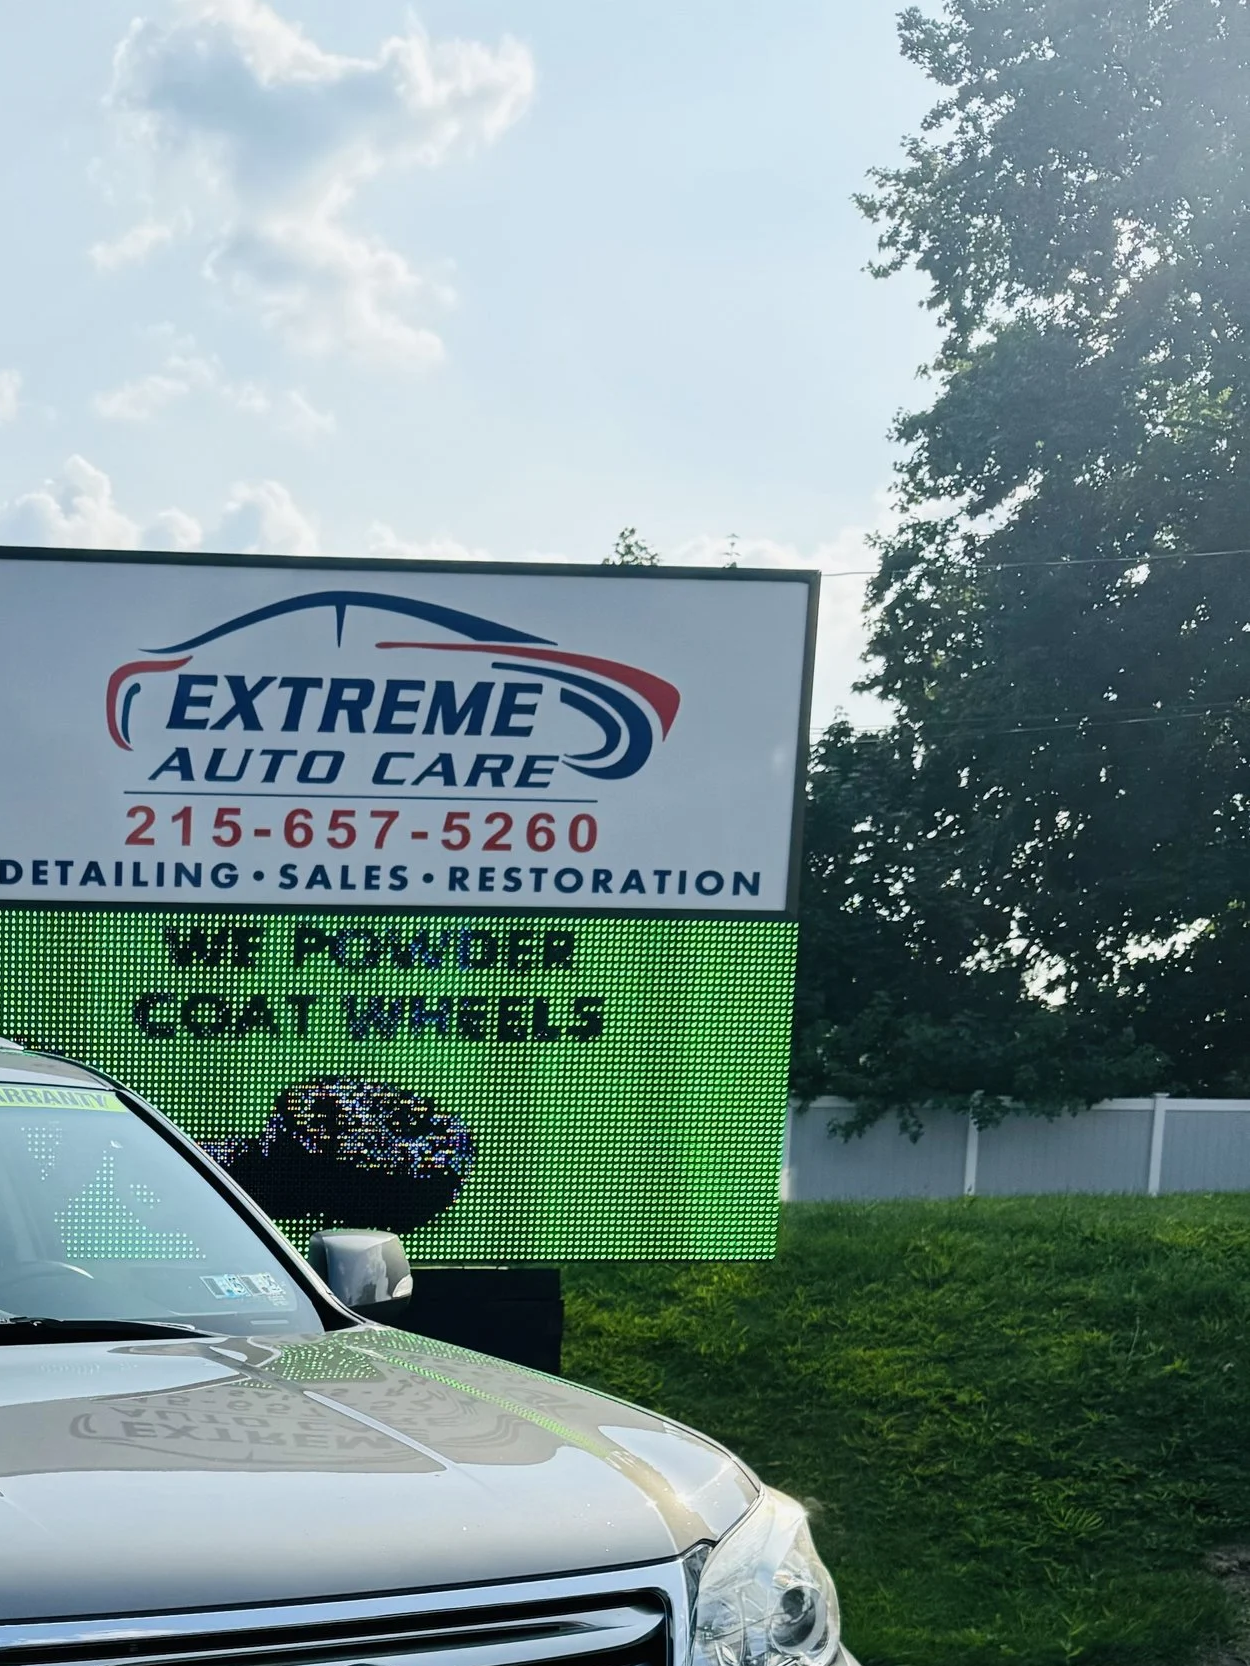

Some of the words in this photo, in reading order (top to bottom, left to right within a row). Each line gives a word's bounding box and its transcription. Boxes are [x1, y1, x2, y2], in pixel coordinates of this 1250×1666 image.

[166, 674, 543, 738] EXTREME
[148, 747, 345, 784] AUTO
[371, 751, 560, 789] CARE
[124, 805, 599, 854] 215-657-5260
[278, 863, 409, 892] SALES
[448, 866, 762, 898] RESTORATION
[164, 924, 261, 970] WE
[293, 927, 577, 973] POWDER
[134, 991, 317, 1041] COAT
[346, 996, 606, 1043] WHEELS
